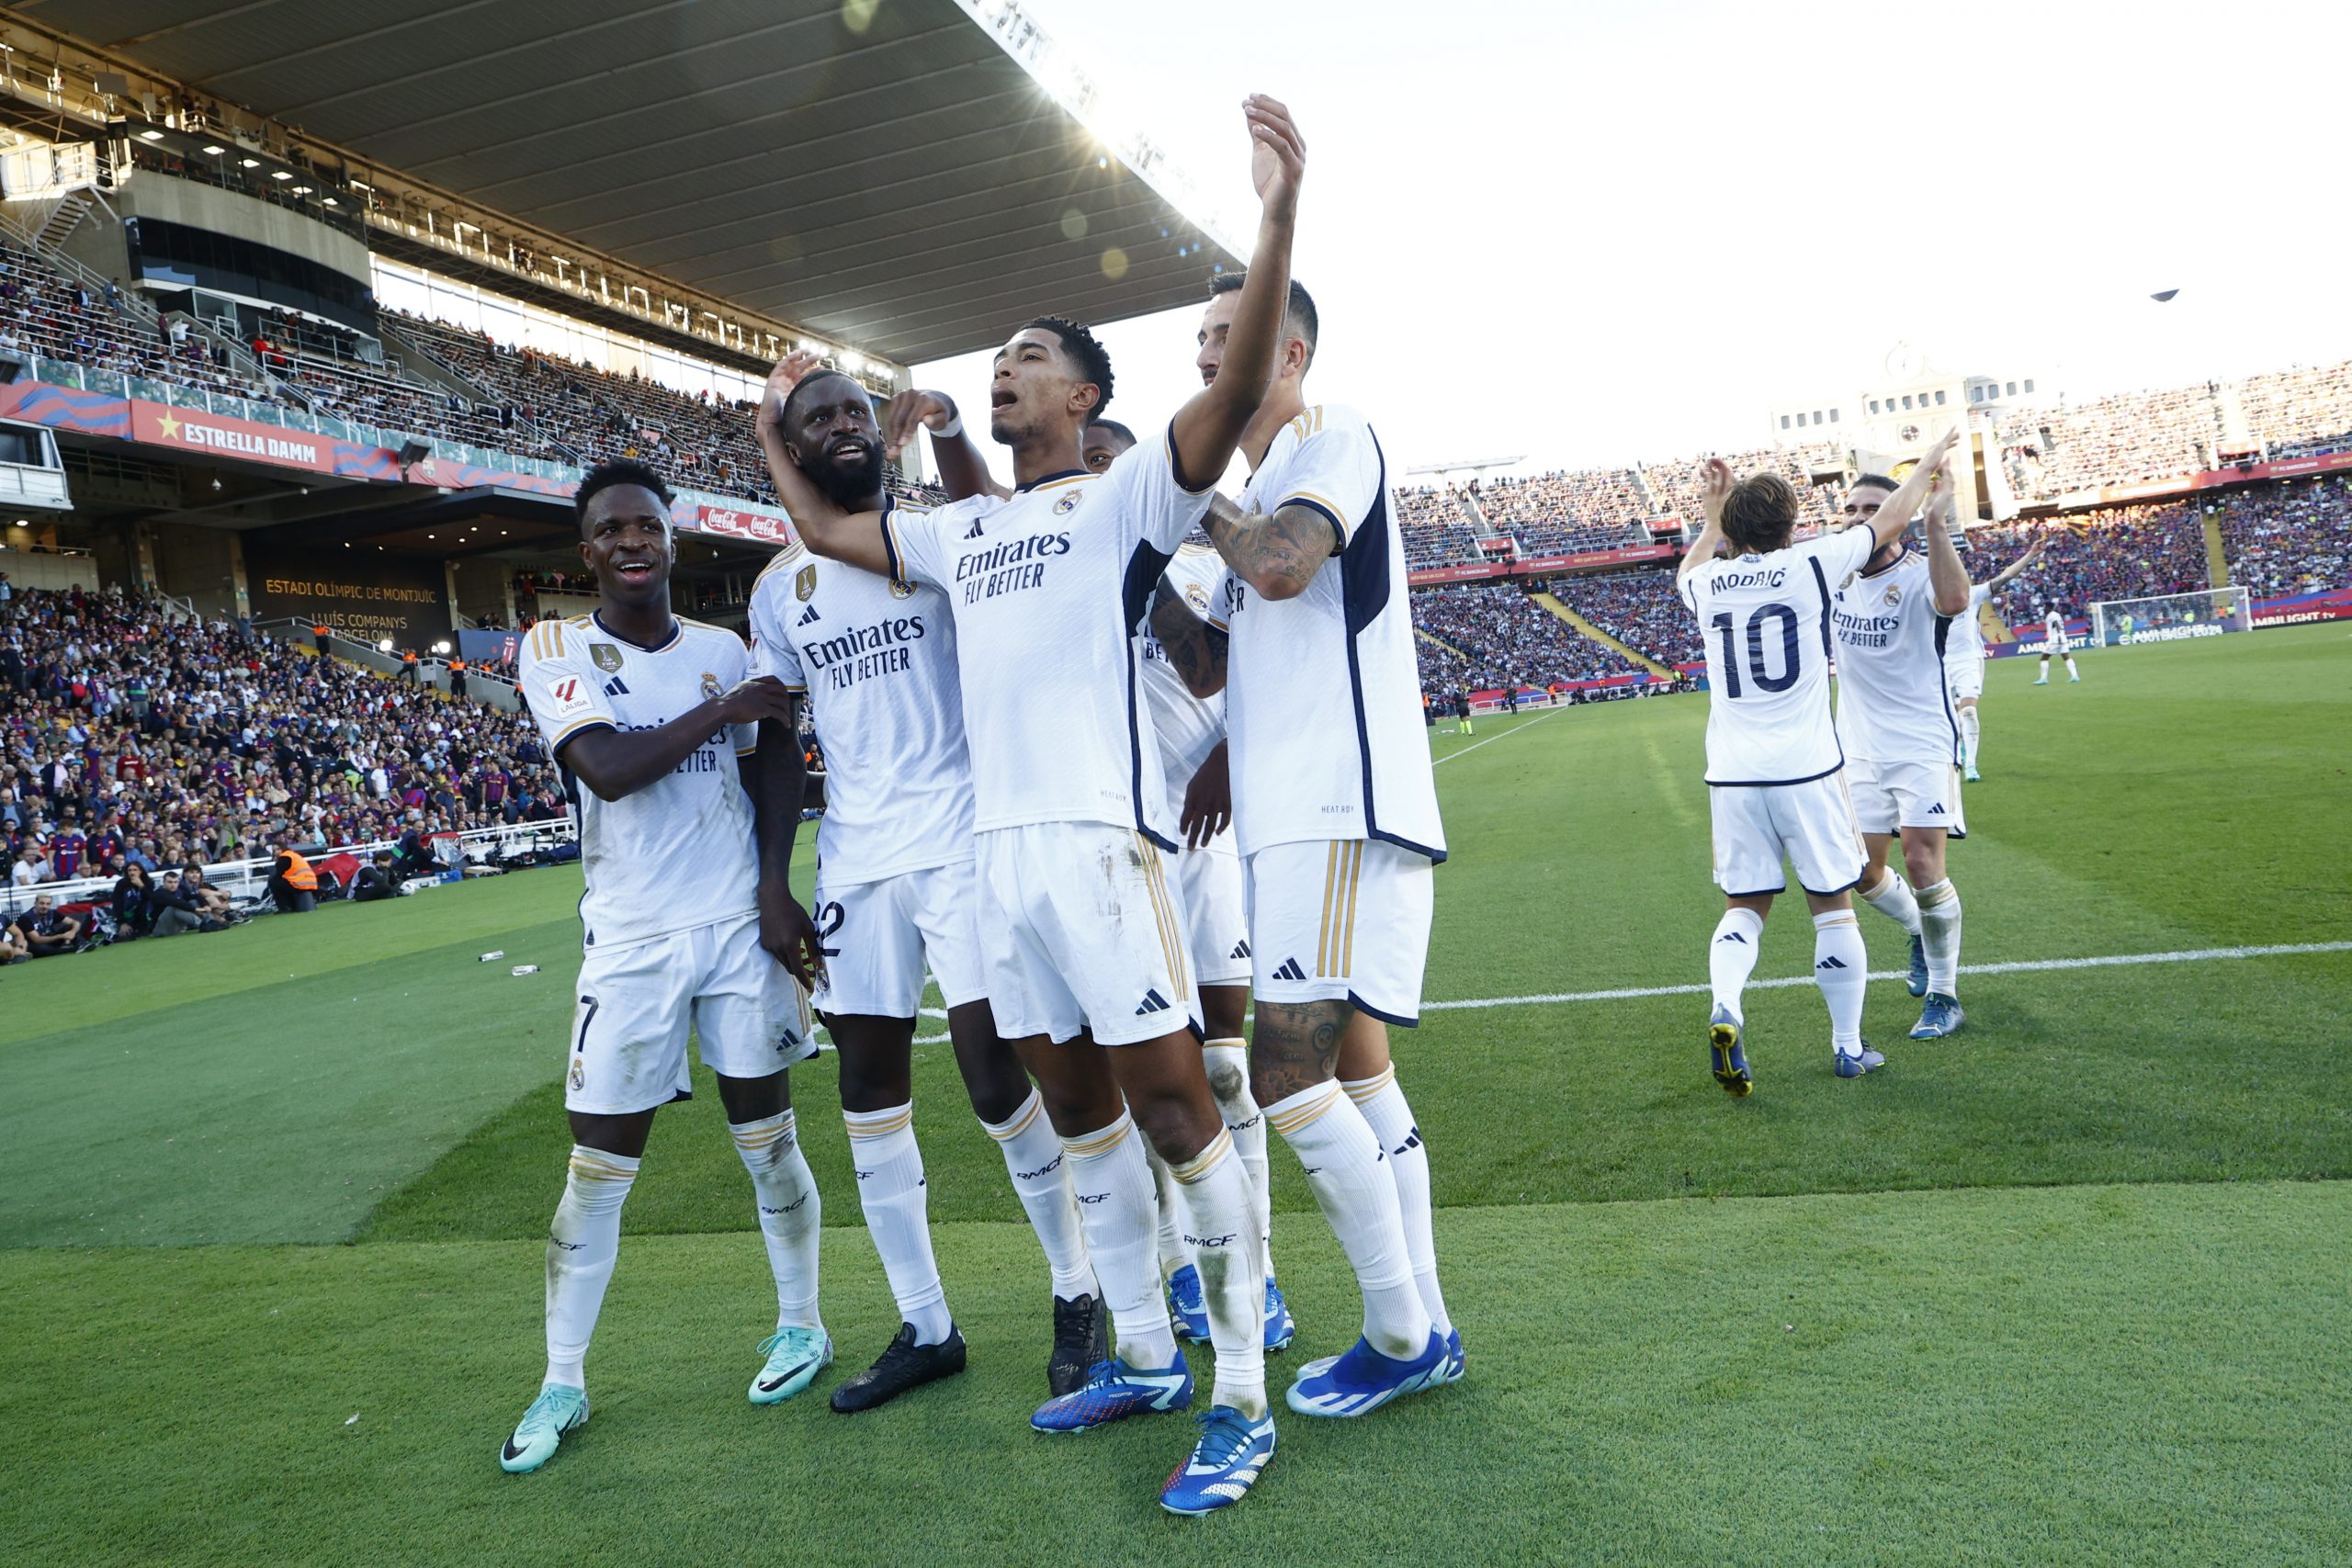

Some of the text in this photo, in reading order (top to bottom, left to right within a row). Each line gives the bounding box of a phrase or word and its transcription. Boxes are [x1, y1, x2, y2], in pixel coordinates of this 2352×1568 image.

[185, 423, 316, 464] ESTRELLA DAMM
[956, 531, 1070, 583] Emirates
[266, 579, 312, 596] ESTADI
[314, 581, 363, 600] OLÍMPIC
[366, 587, 380, 600] DE
[965, 562, 1045, 606] FLY BETTER
[336, 628, 395, 642] ARCELONA
[348, 614, 408, 629] COMPANYS
[802, 615, 925, 670] Emirates
[1712, 604, 1801, 698] 10
[1849, 633, 1887, 648] BETTER
[831, 647, 910, 690] FLY BETTER
[560, 700, 588, 714] LALIGA
[577, 995, 600, 1054] 7
[1227, 1112, 1261, 1131] MCF
[1183, 1234, 1238, 1247] RMCF
